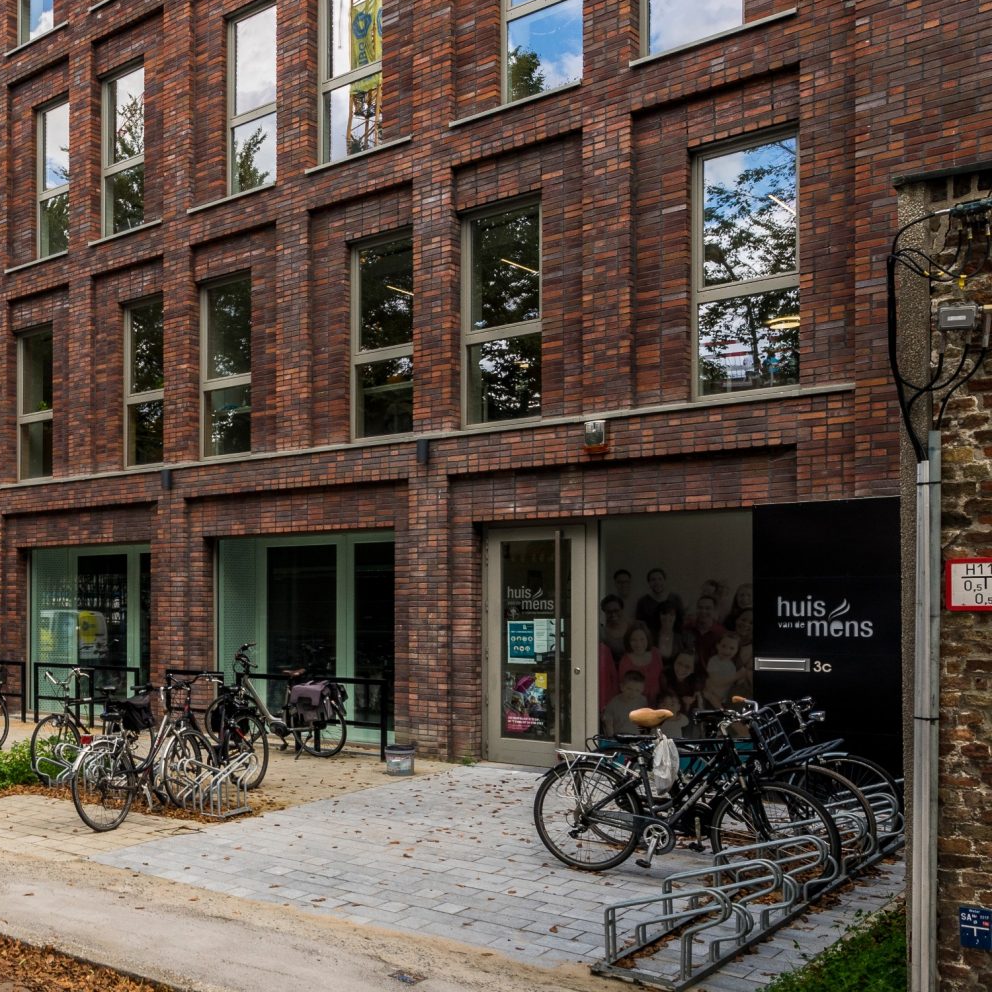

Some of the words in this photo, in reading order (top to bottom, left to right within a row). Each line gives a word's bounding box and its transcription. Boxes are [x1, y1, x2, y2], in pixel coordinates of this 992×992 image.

[964, 579, 983, 592] 0,5
[508, 586, 532, 599] huis
[522, 599, 554, 610] mens
[777, 595, 826, 617] huis
[807, 620, 873, 637] mens
